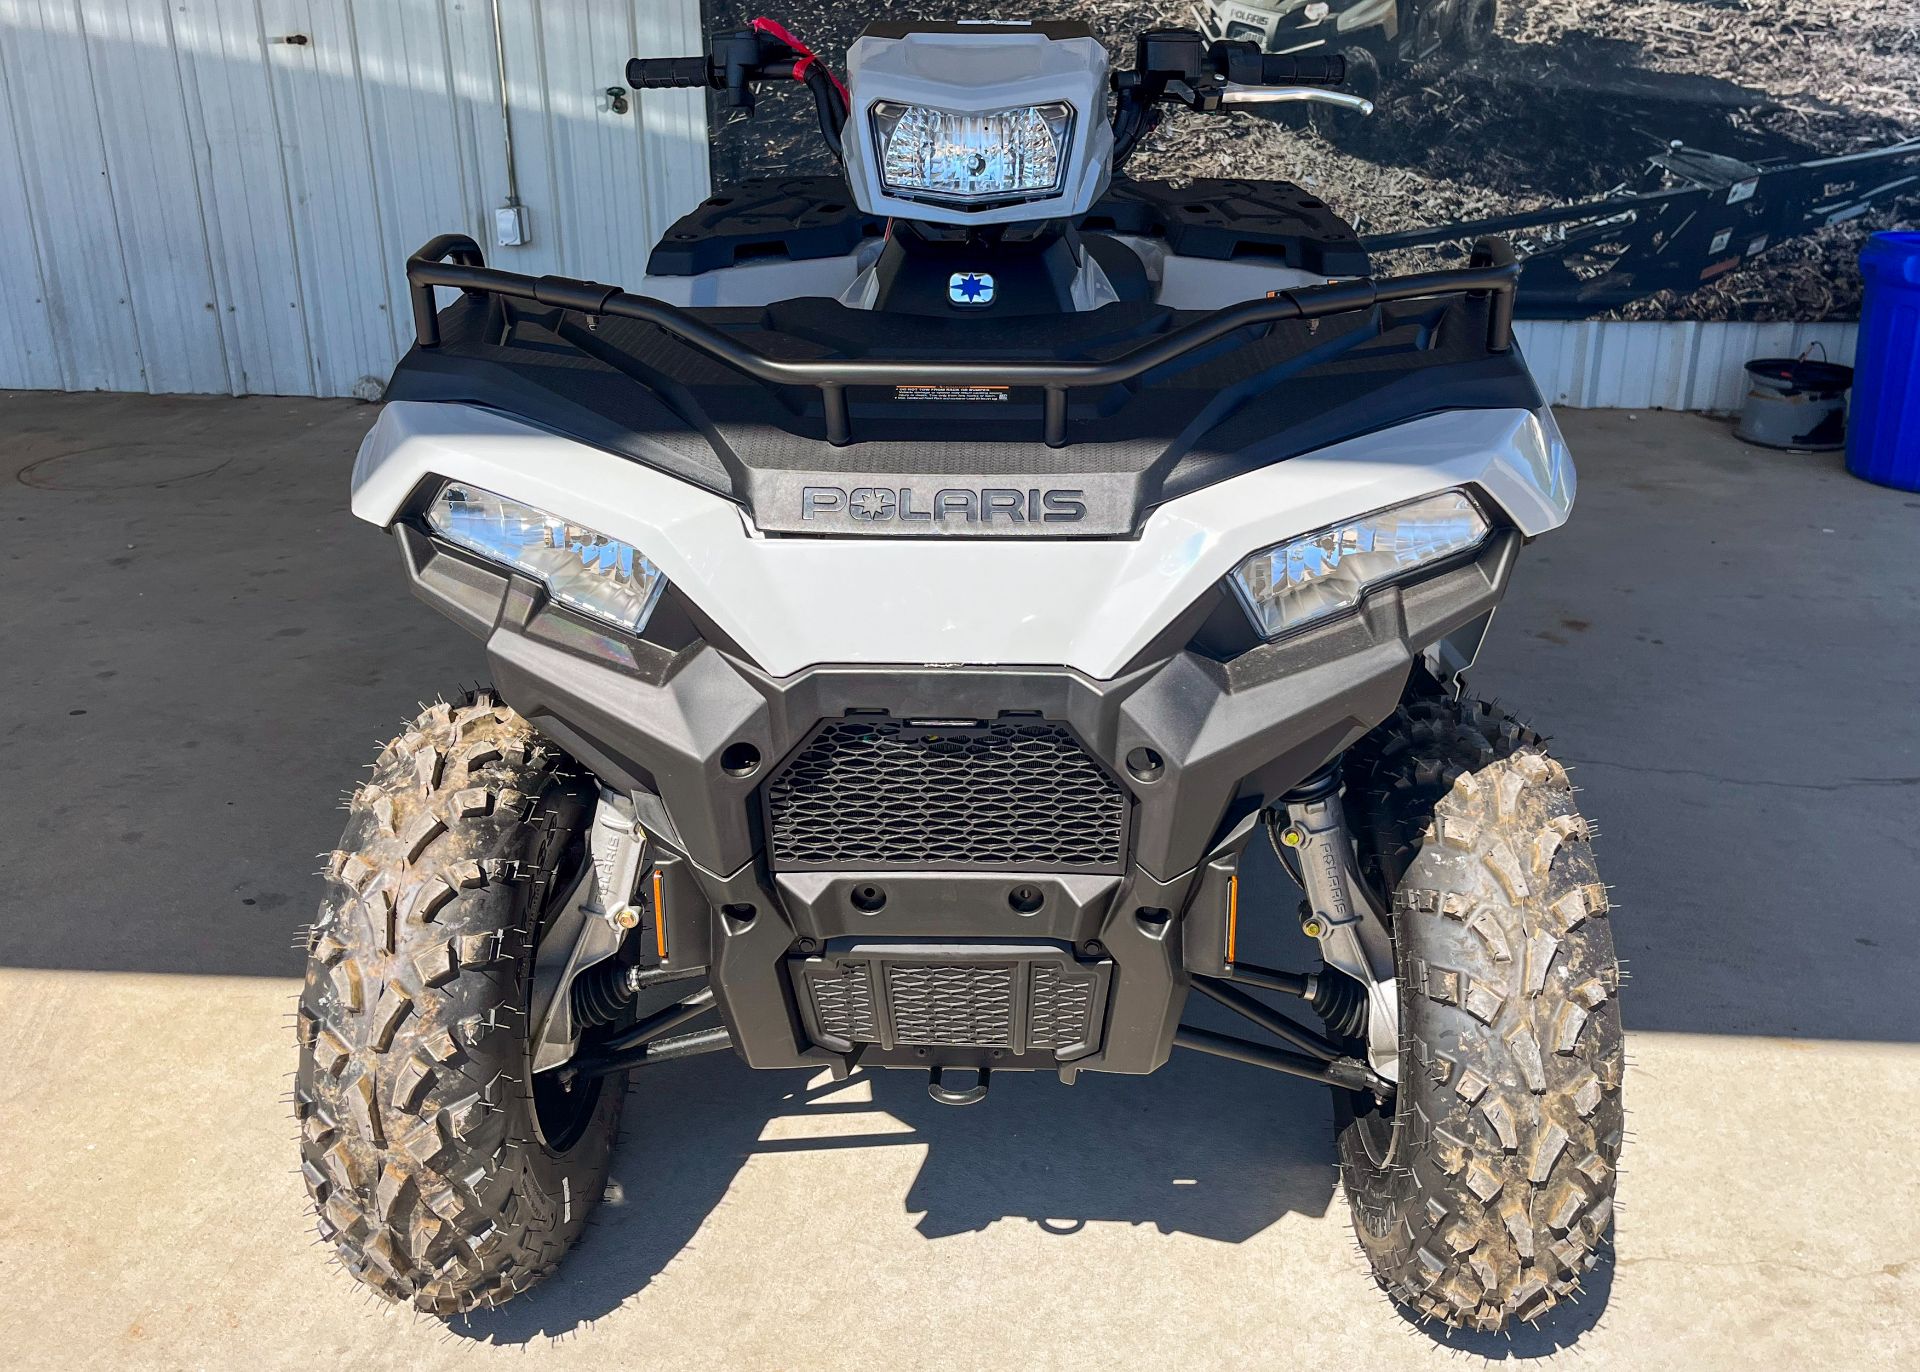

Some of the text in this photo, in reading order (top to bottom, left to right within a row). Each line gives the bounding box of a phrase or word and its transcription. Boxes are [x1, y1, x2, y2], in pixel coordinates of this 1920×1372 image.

[801, 486, 1088, 523] POLARIS
[596, 834, 619, 905] POLARIS
[1320, 842, 1347, 914] POLARIS
